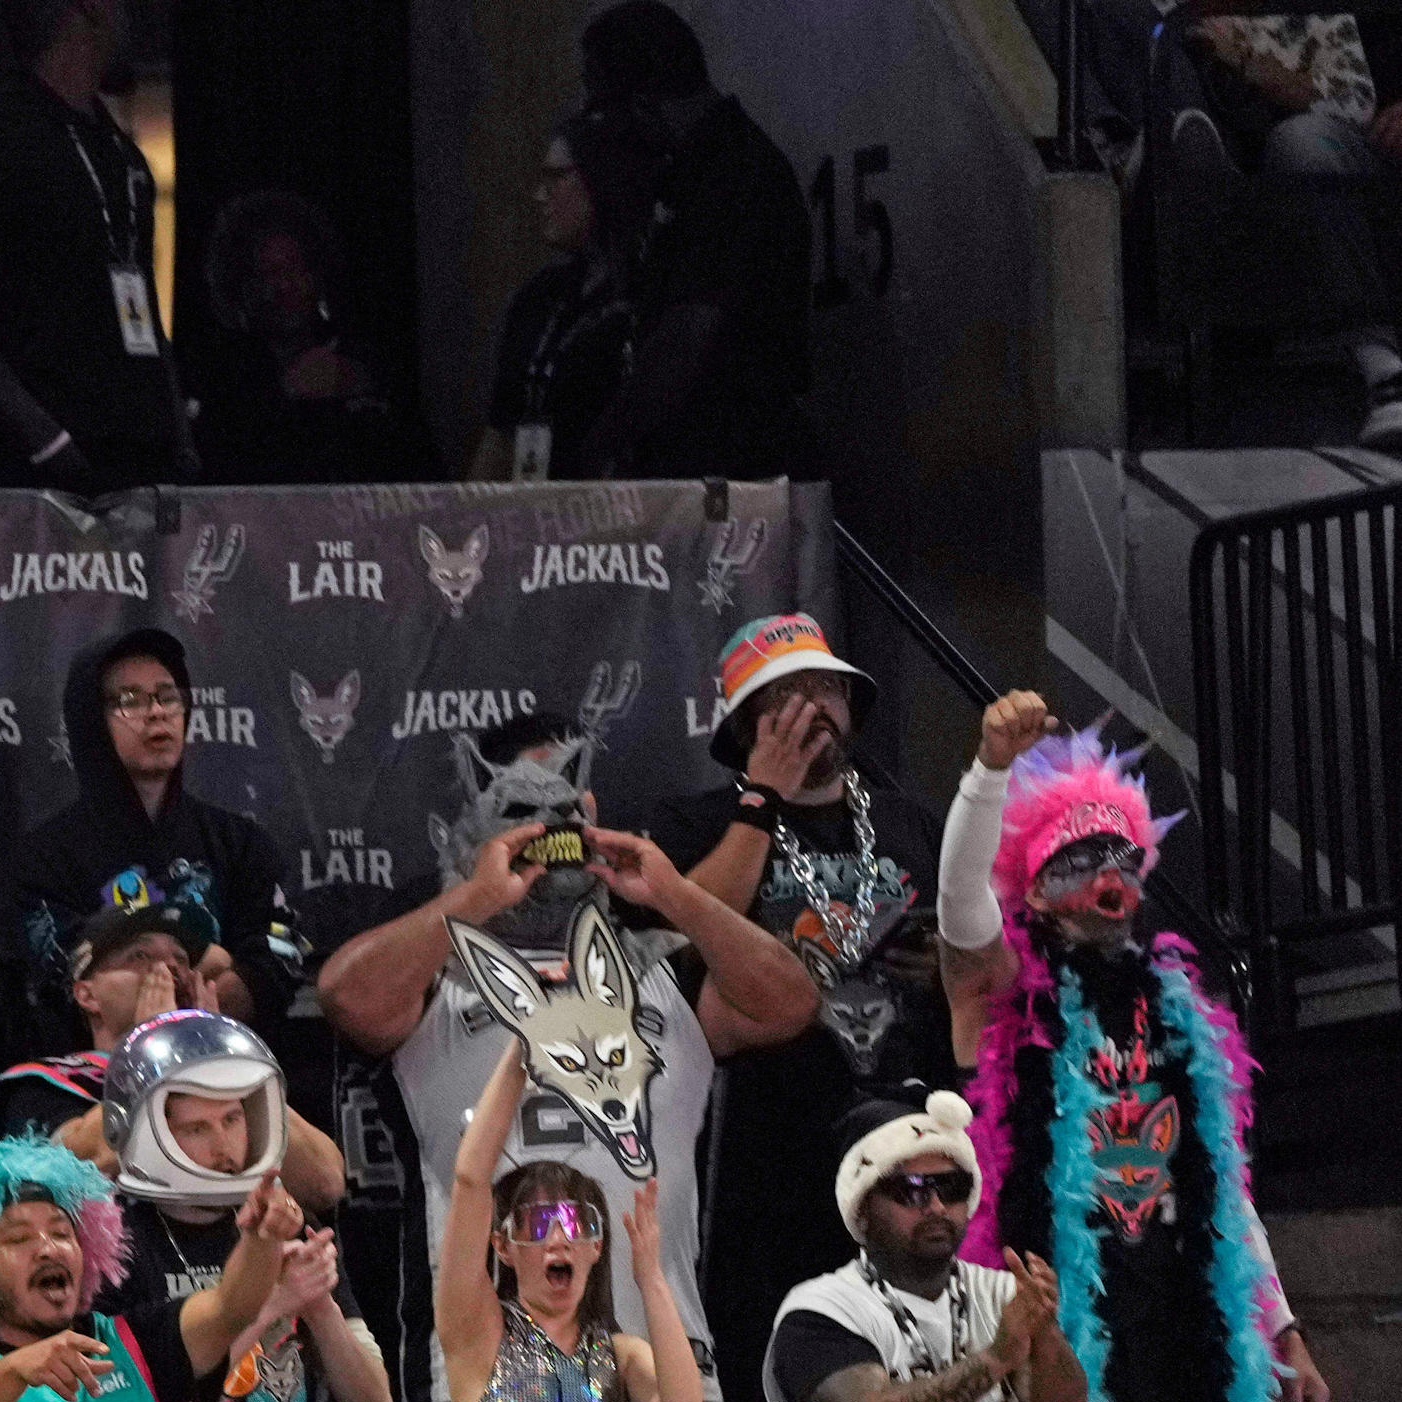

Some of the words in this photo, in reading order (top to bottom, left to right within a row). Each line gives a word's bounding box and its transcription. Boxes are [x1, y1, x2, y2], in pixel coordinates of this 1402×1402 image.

[316, 540, 353, 560] THE
[520, 543, 671, 596] JACKALS
[0, 551, 149, 602] JACKALS
[289, 561, 385, 603] LAIR
[190, 686, 227, 706] THE
[185, 707, 258, 750] AIR
[328, 827, 364, 847] THE
[300, 848, 396, 891] LAIR
